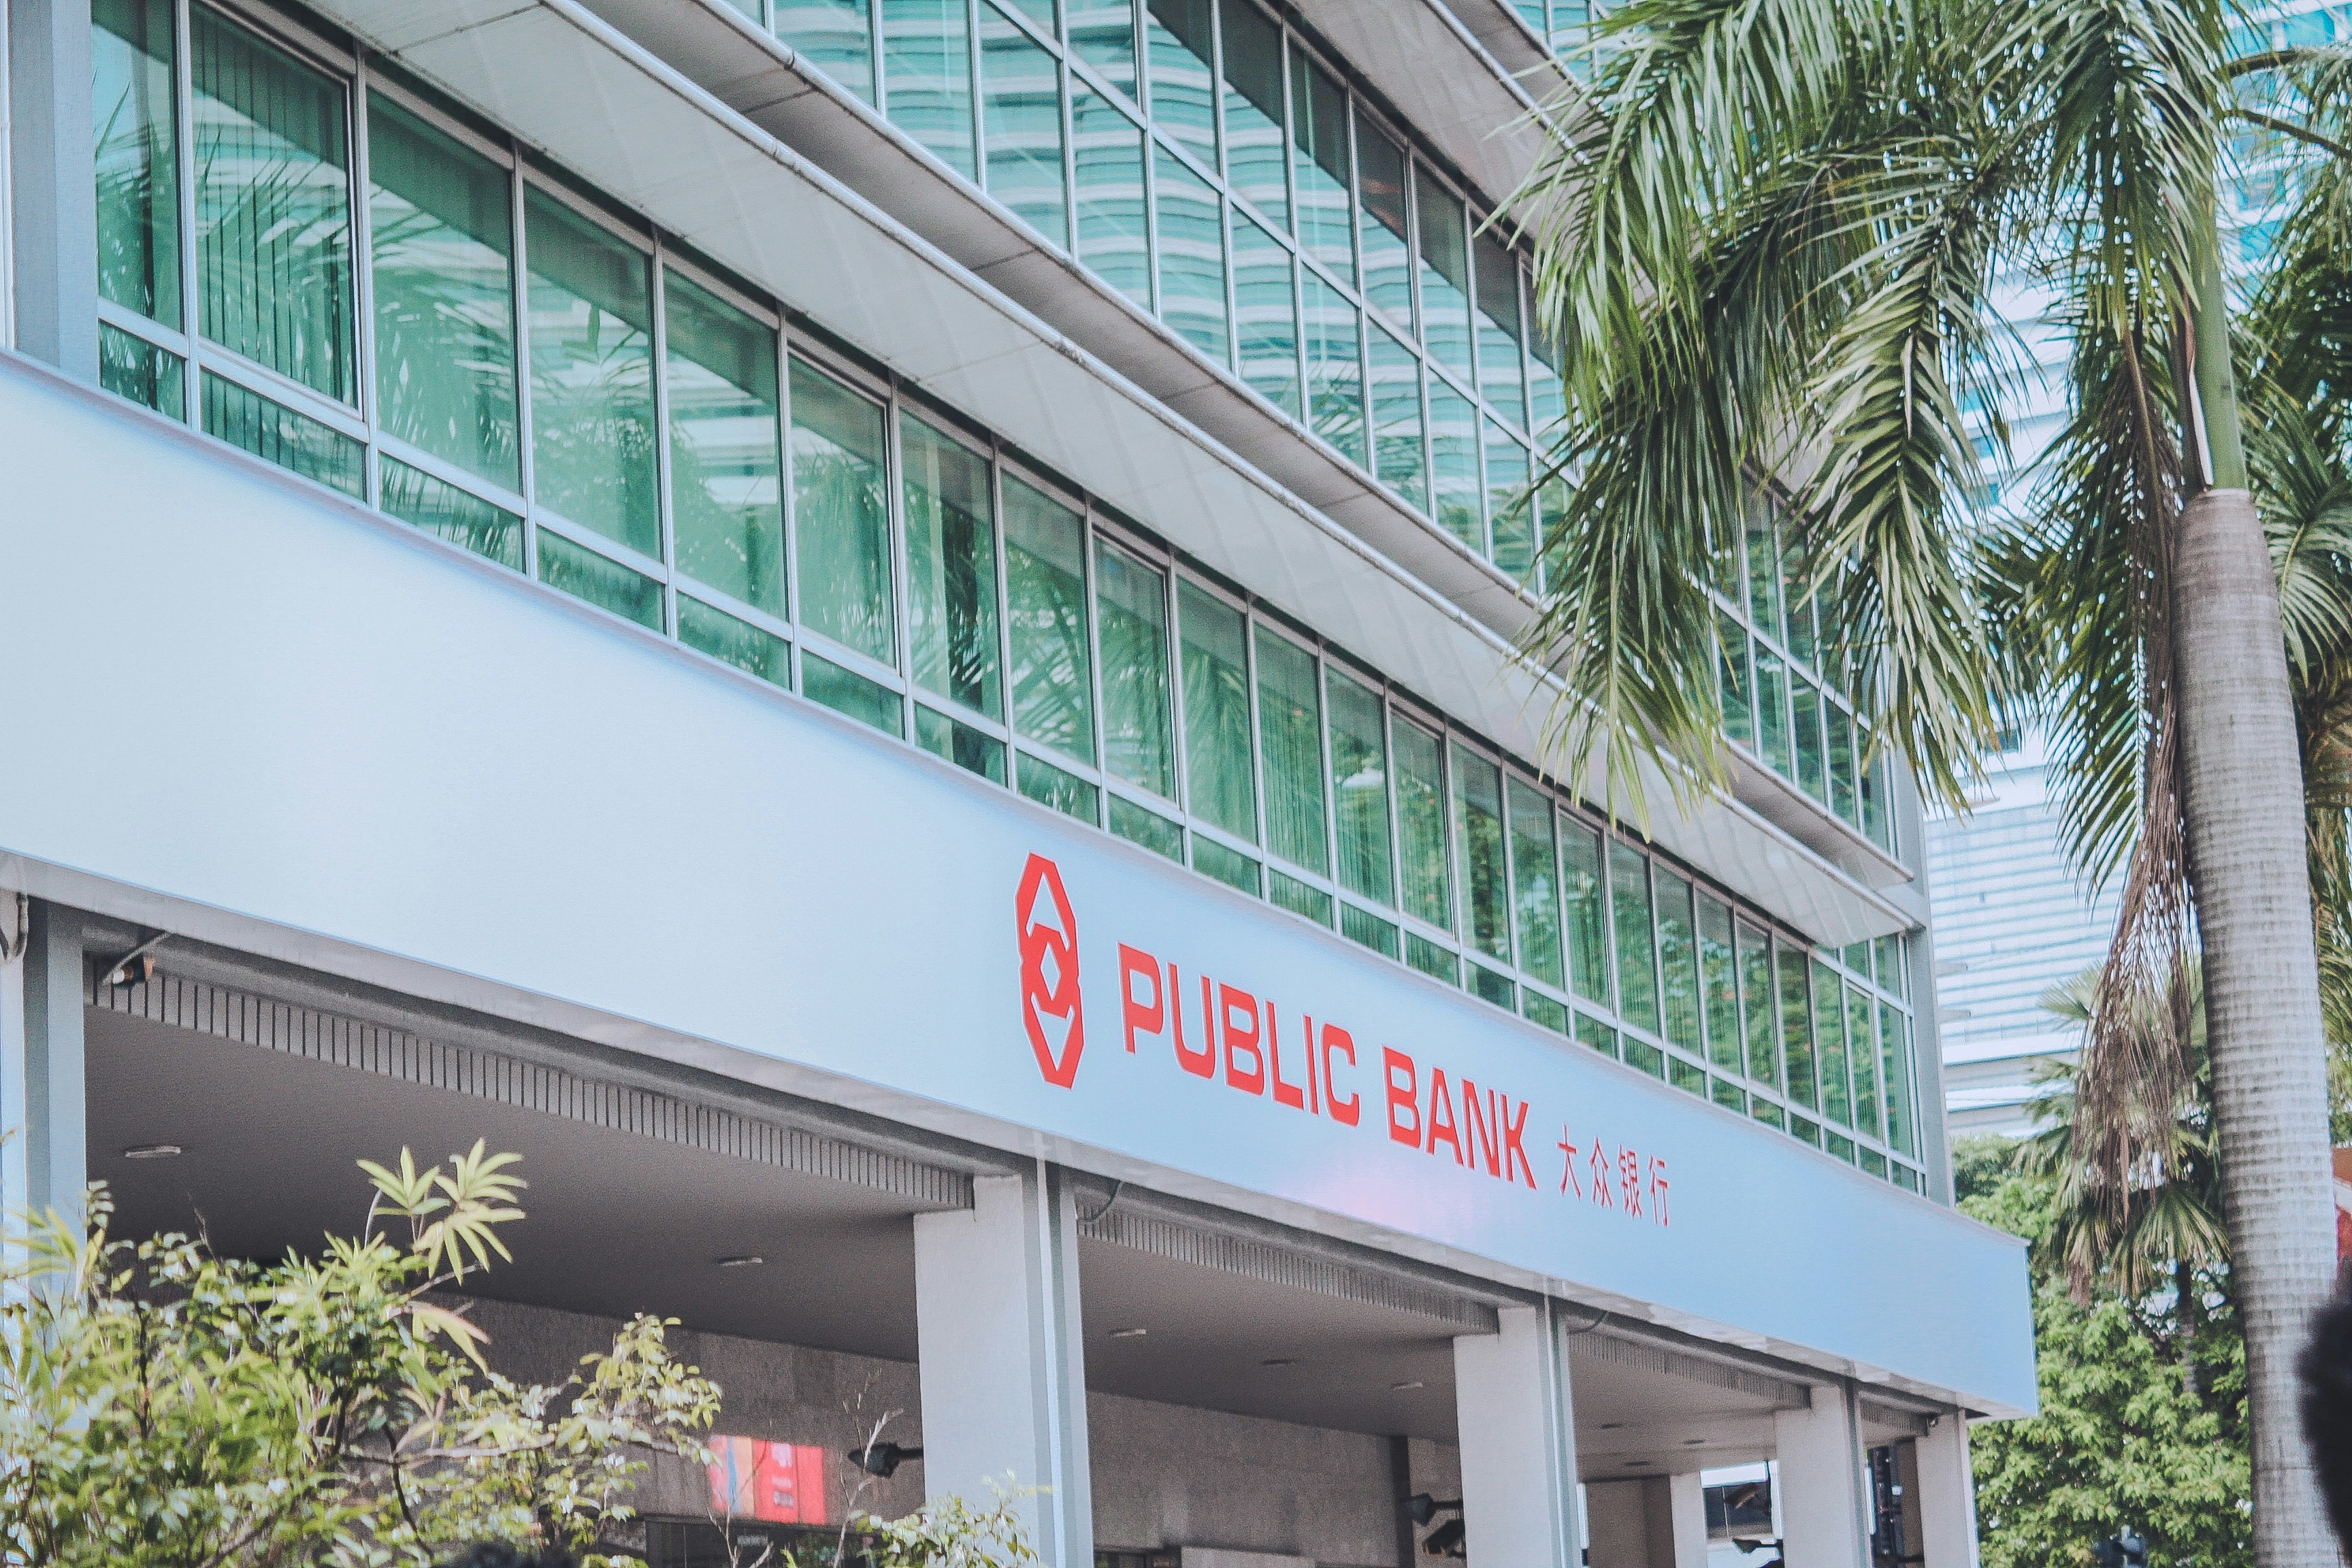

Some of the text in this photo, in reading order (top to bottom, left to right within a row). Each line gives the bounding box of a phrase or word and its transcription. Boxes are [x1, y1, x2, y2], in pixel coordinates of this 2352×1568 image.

[1118, 942, 1537, 1190] PUBLIC BANK
[1556, 1123, 1669, 1227] 大众银行
